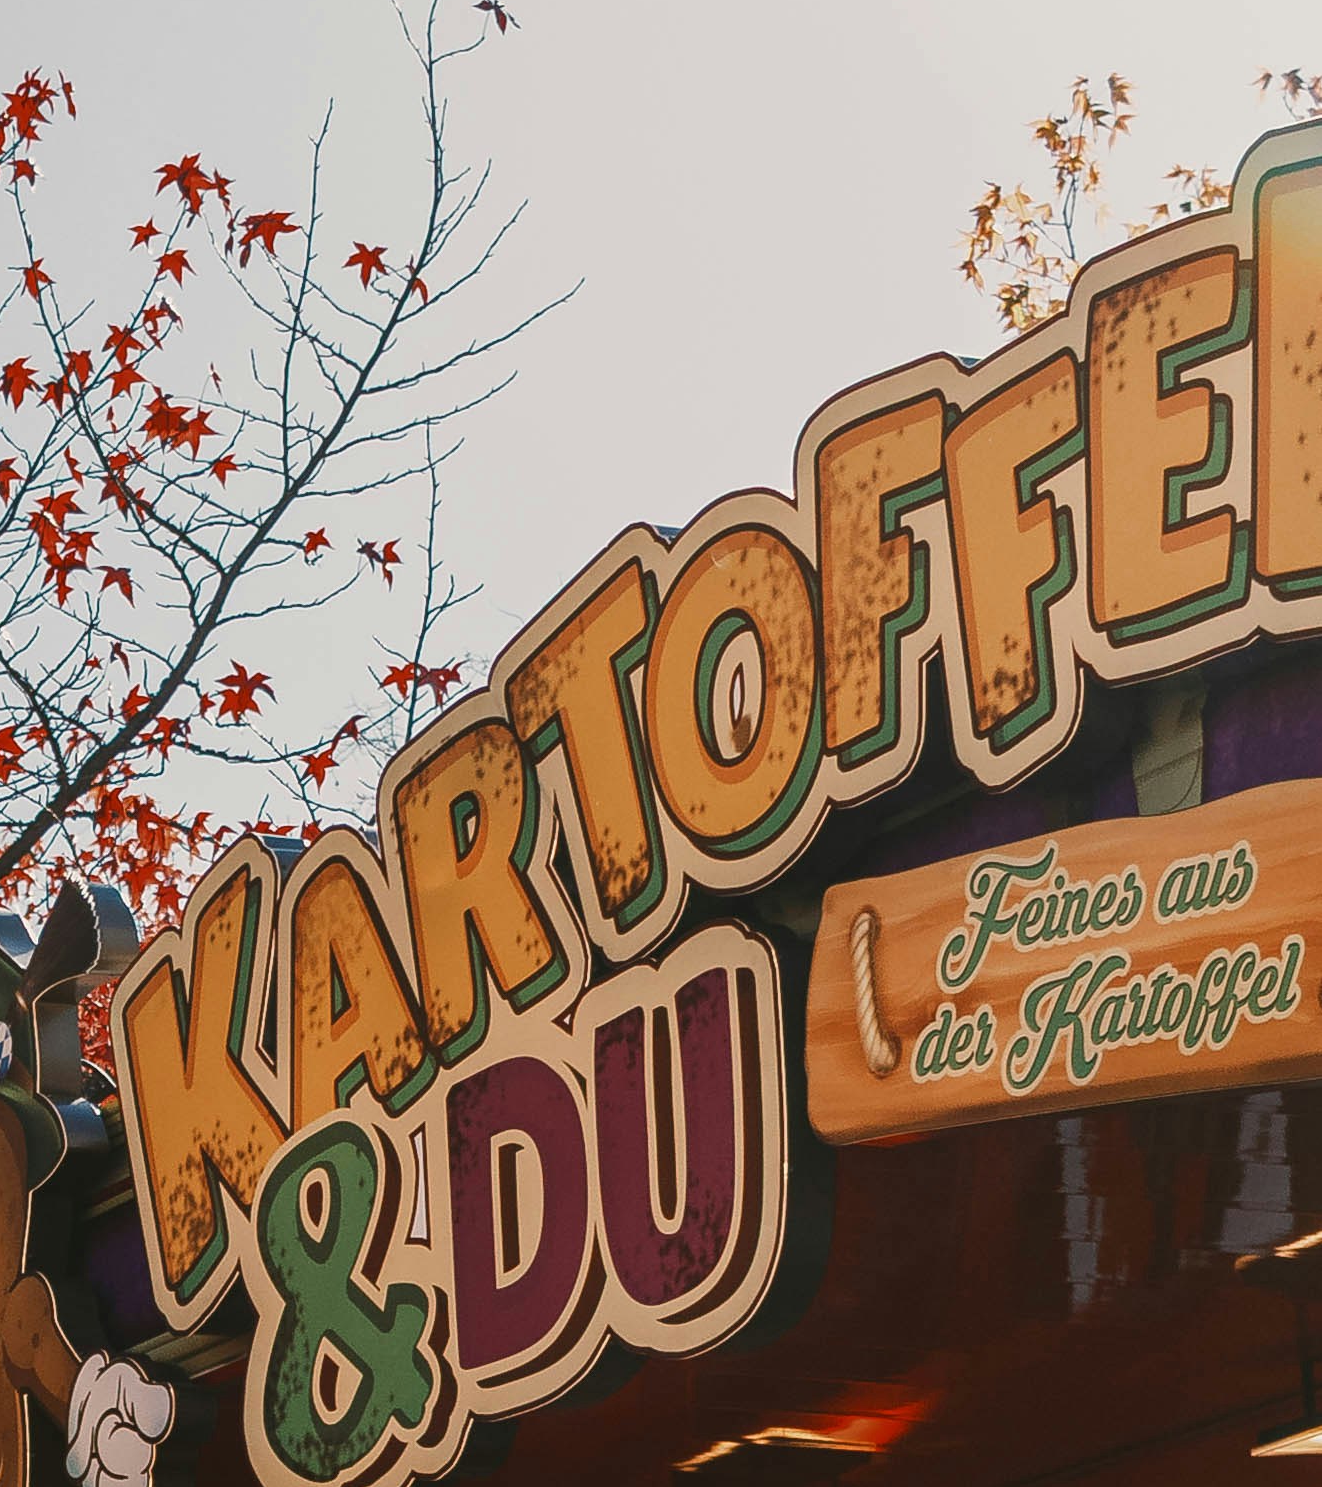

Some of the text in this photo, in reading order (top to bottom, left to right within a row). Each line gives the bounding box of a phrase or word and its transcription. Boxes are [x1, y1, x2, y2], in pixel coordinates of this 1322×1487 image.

[939, 845, 1254, 989] Feines aus
[914, 941, 1301, 1091] der Kartoffel
[258, 965, 762, 1478] & DU
